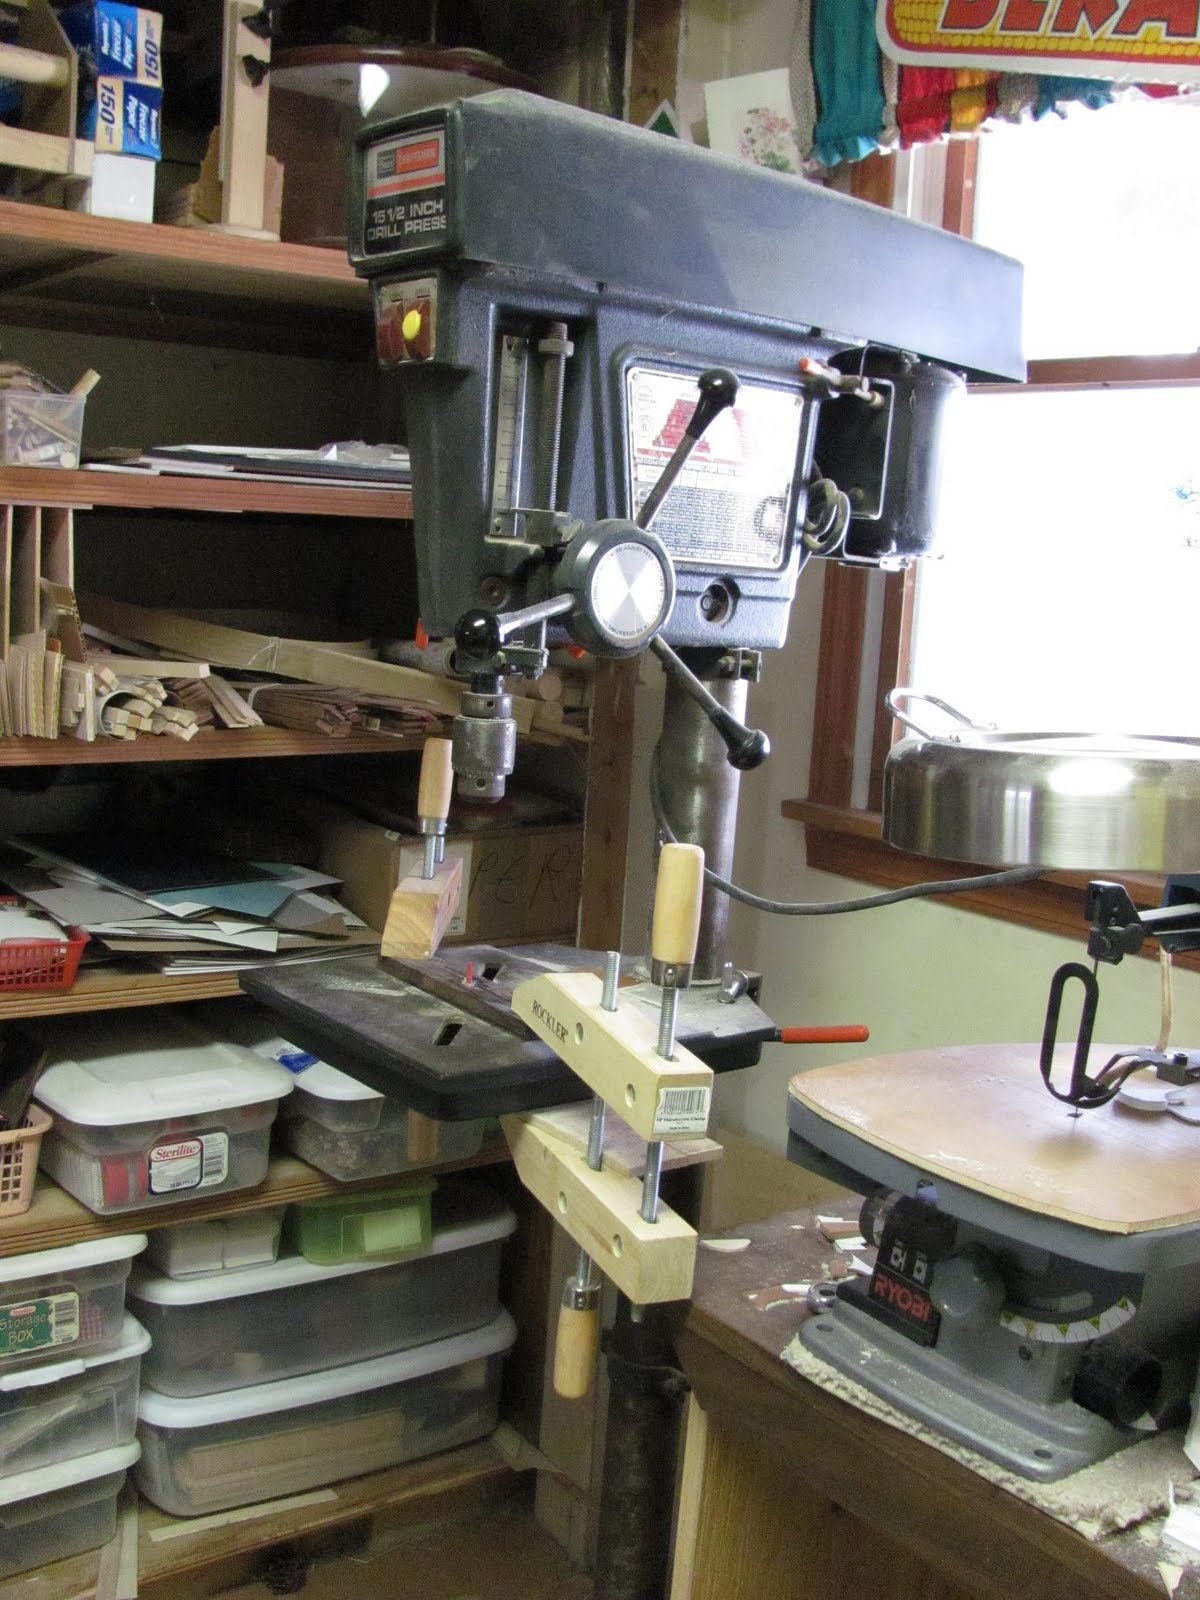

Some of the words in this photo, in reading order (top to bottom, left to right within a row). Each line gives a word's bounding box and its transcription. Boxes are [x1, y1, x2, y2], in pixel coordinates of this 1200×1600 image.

[145, 39, 158, 79] 150
[101, 83, 115, 125] 150
[409, 199, 444, 218] INCH
[367, 223, 402, 241] DRILL
[404, 215, 447, 235] PRESS
[531, 999, 567, 1043] ROCKLER
[156, 1144, 195, 1160] Sterilite
[874, 1273, 930, 1323] RYOBI
[0, 1313, 47, 1331] Storage
[8, 1327, 34, 1346] BOX
